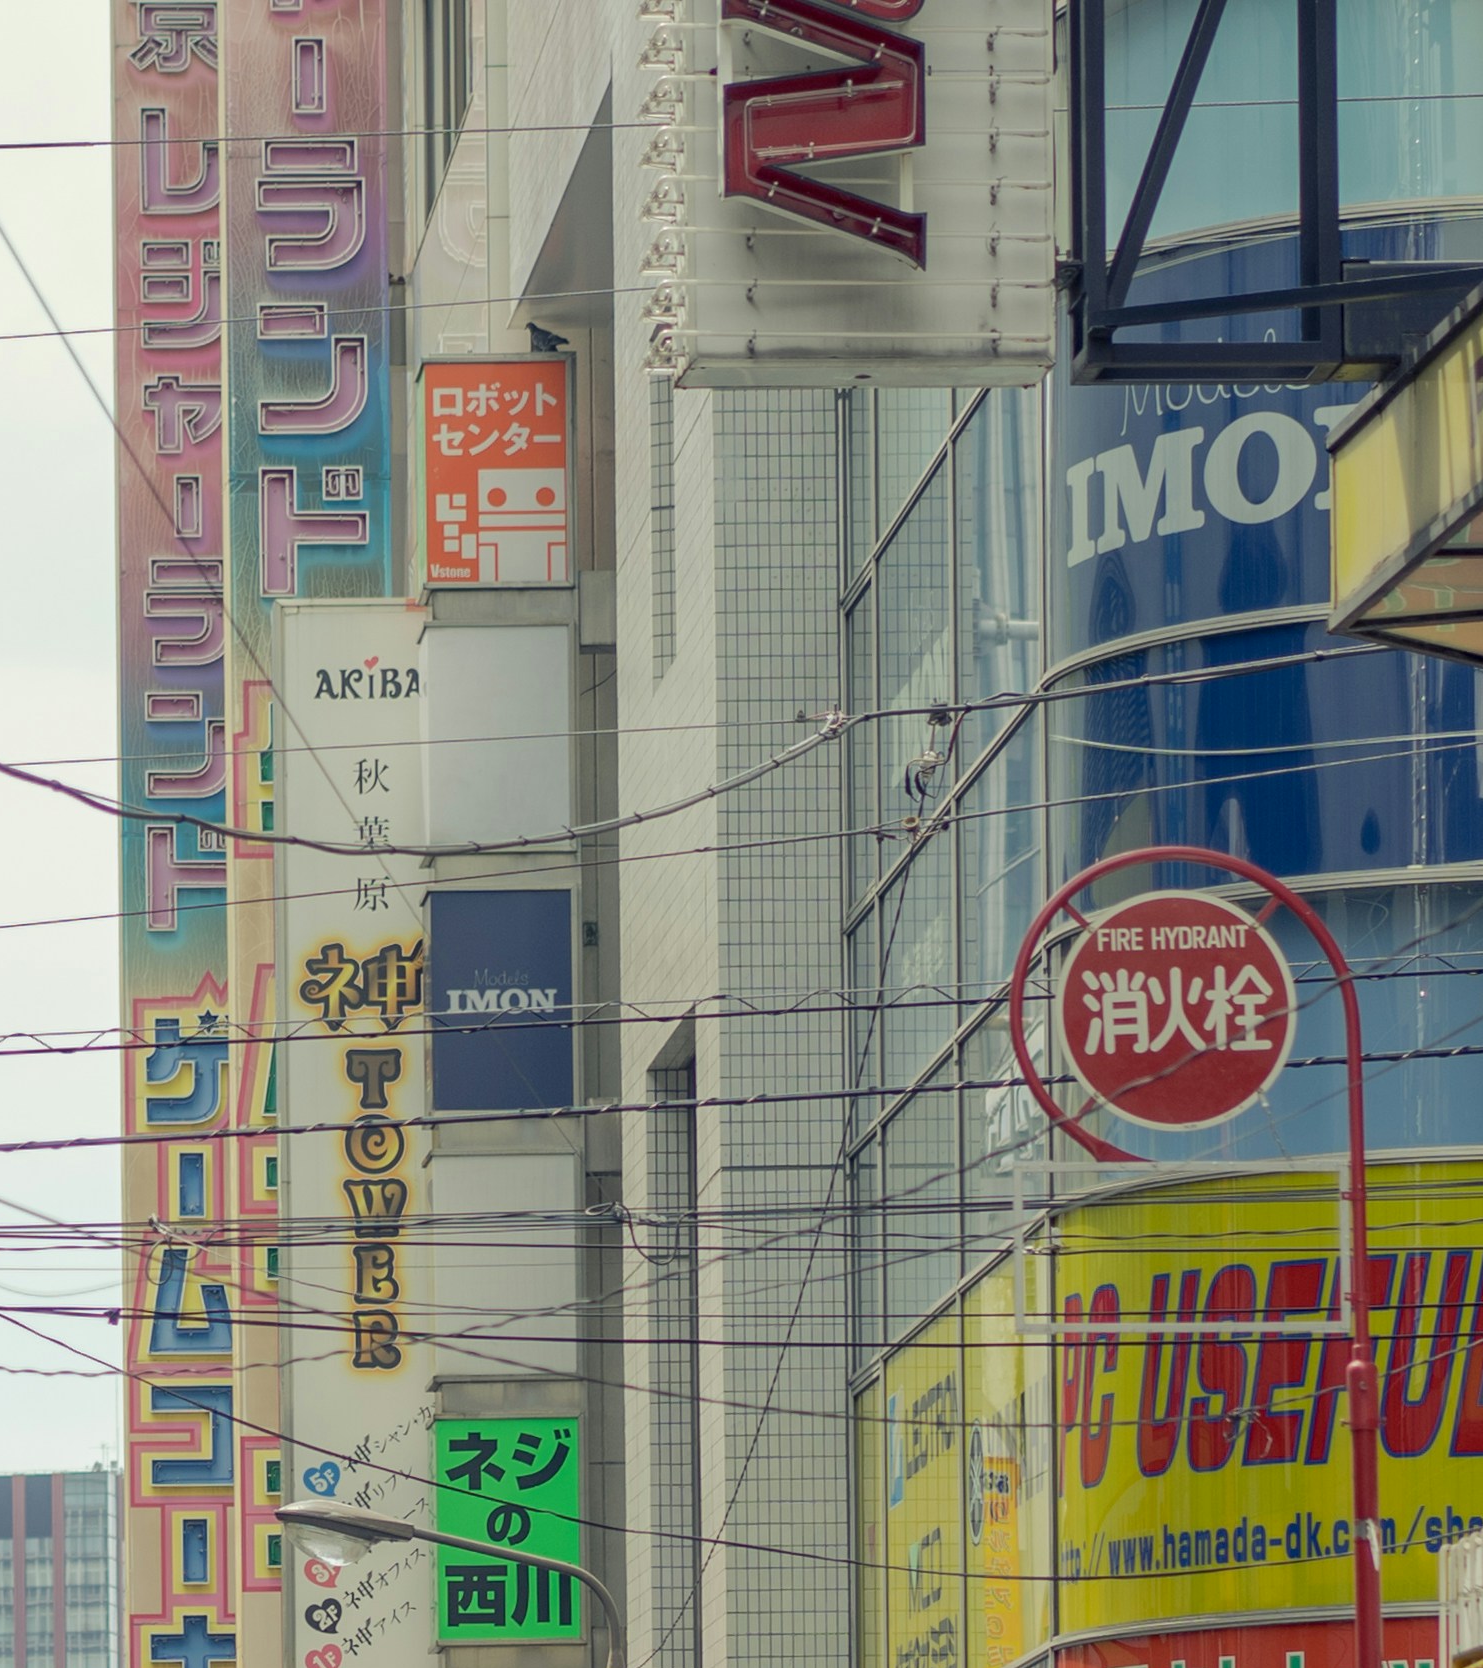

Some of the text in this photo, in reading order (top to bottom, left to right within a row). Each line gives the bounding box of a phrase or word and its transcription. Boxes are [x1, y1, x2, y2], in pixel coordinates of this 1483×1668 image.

[431, 385, 558, 418] ロボット
[431, 421, 562, 457] センター
[430, 563, 472, 580] Vstone
[352, 757, 391, 914] 秋葉原
[1096, 924, 1249, 953] FIRE HYDRANT
[446, 987, 558, 1016] IMON
[1081, 964, 1274, 1057] 消火栓
[343, 1047, 409, 1371] TOWER
[445, 1429, 572, 1492] ネジ
[485, 1503, 532, 1547] の
[445, 1564, 575, 1628] 西川
